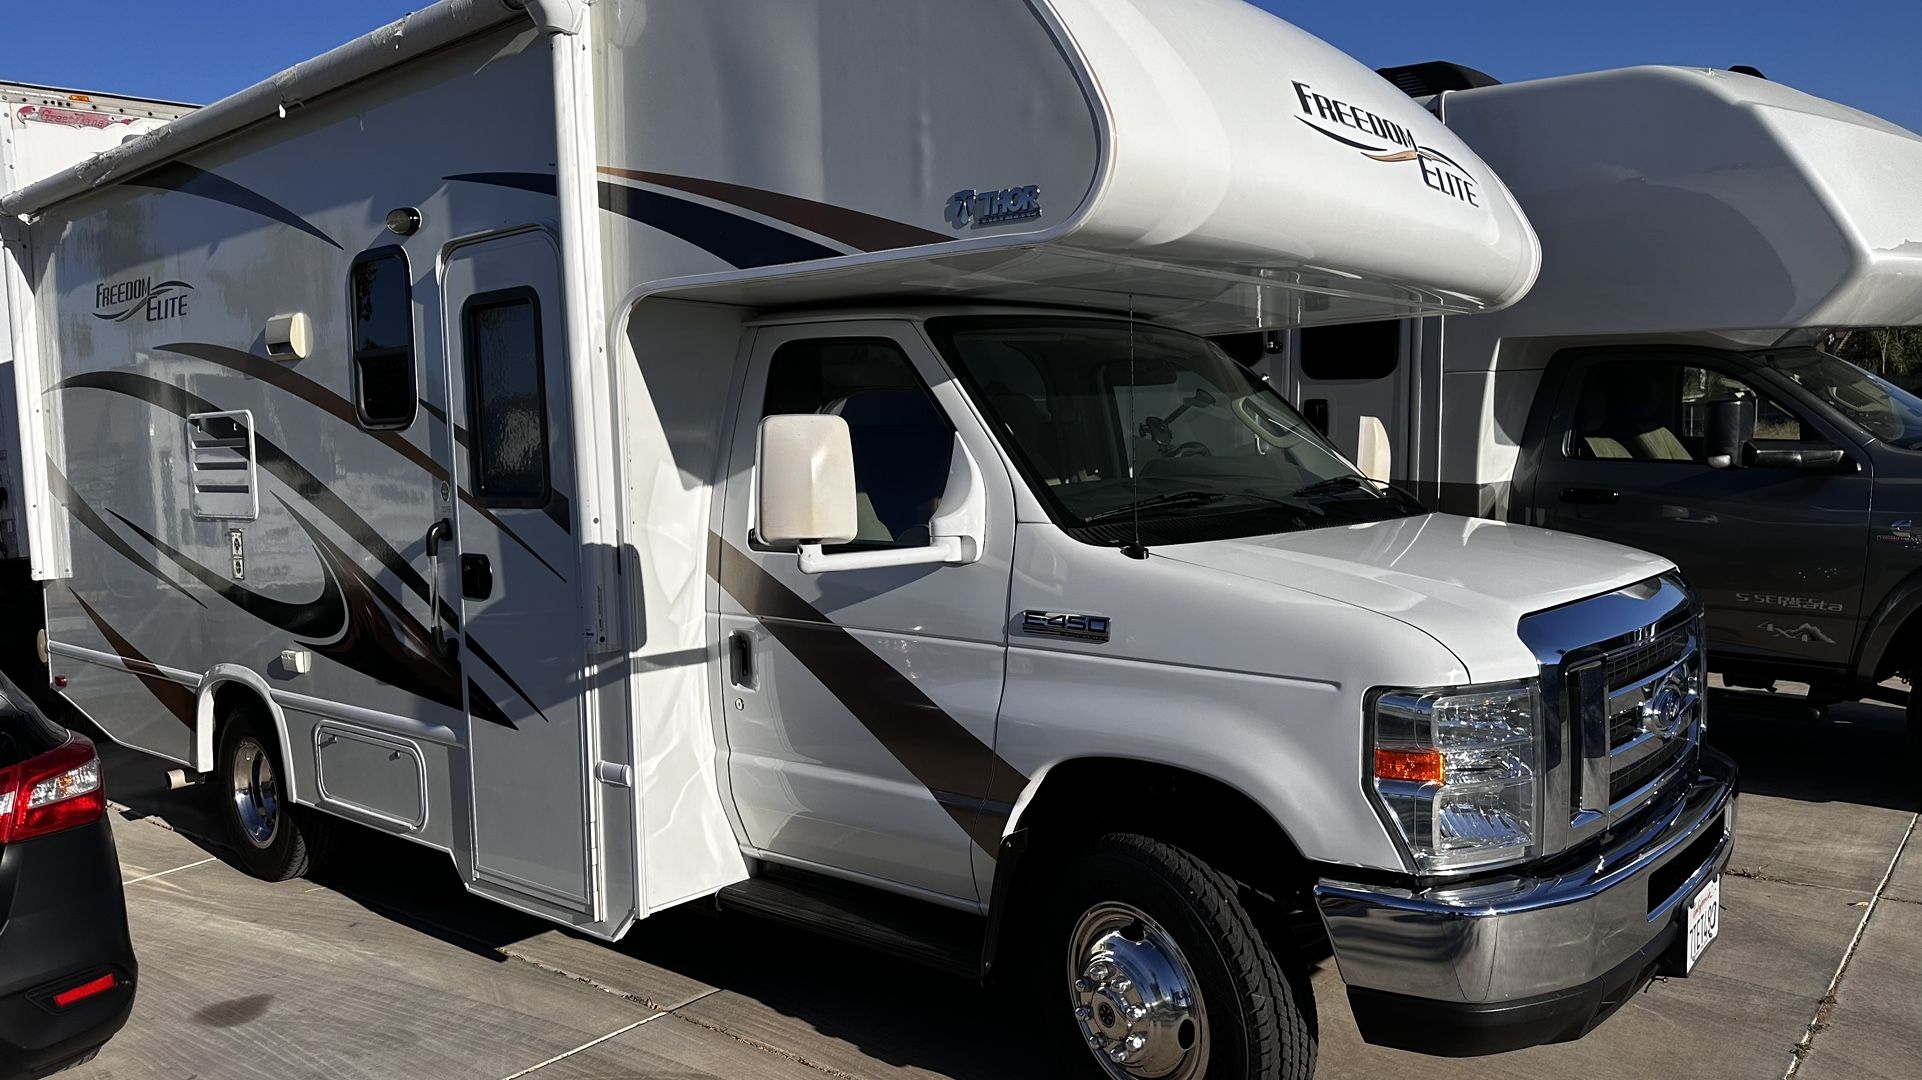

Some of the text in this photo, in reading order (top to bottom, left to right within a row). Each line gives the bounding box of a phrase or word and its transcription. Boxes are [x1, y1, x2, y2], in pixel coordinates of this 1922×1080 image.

[1291, 79, 1418, 152] FREEDOM
[1417, 153, 1479, 208] ELITE
[979, 185, 1040, 216] THOR
[95, 276, 151, 309] FREEDOM
[146, 294, 188, 322] ELITE
